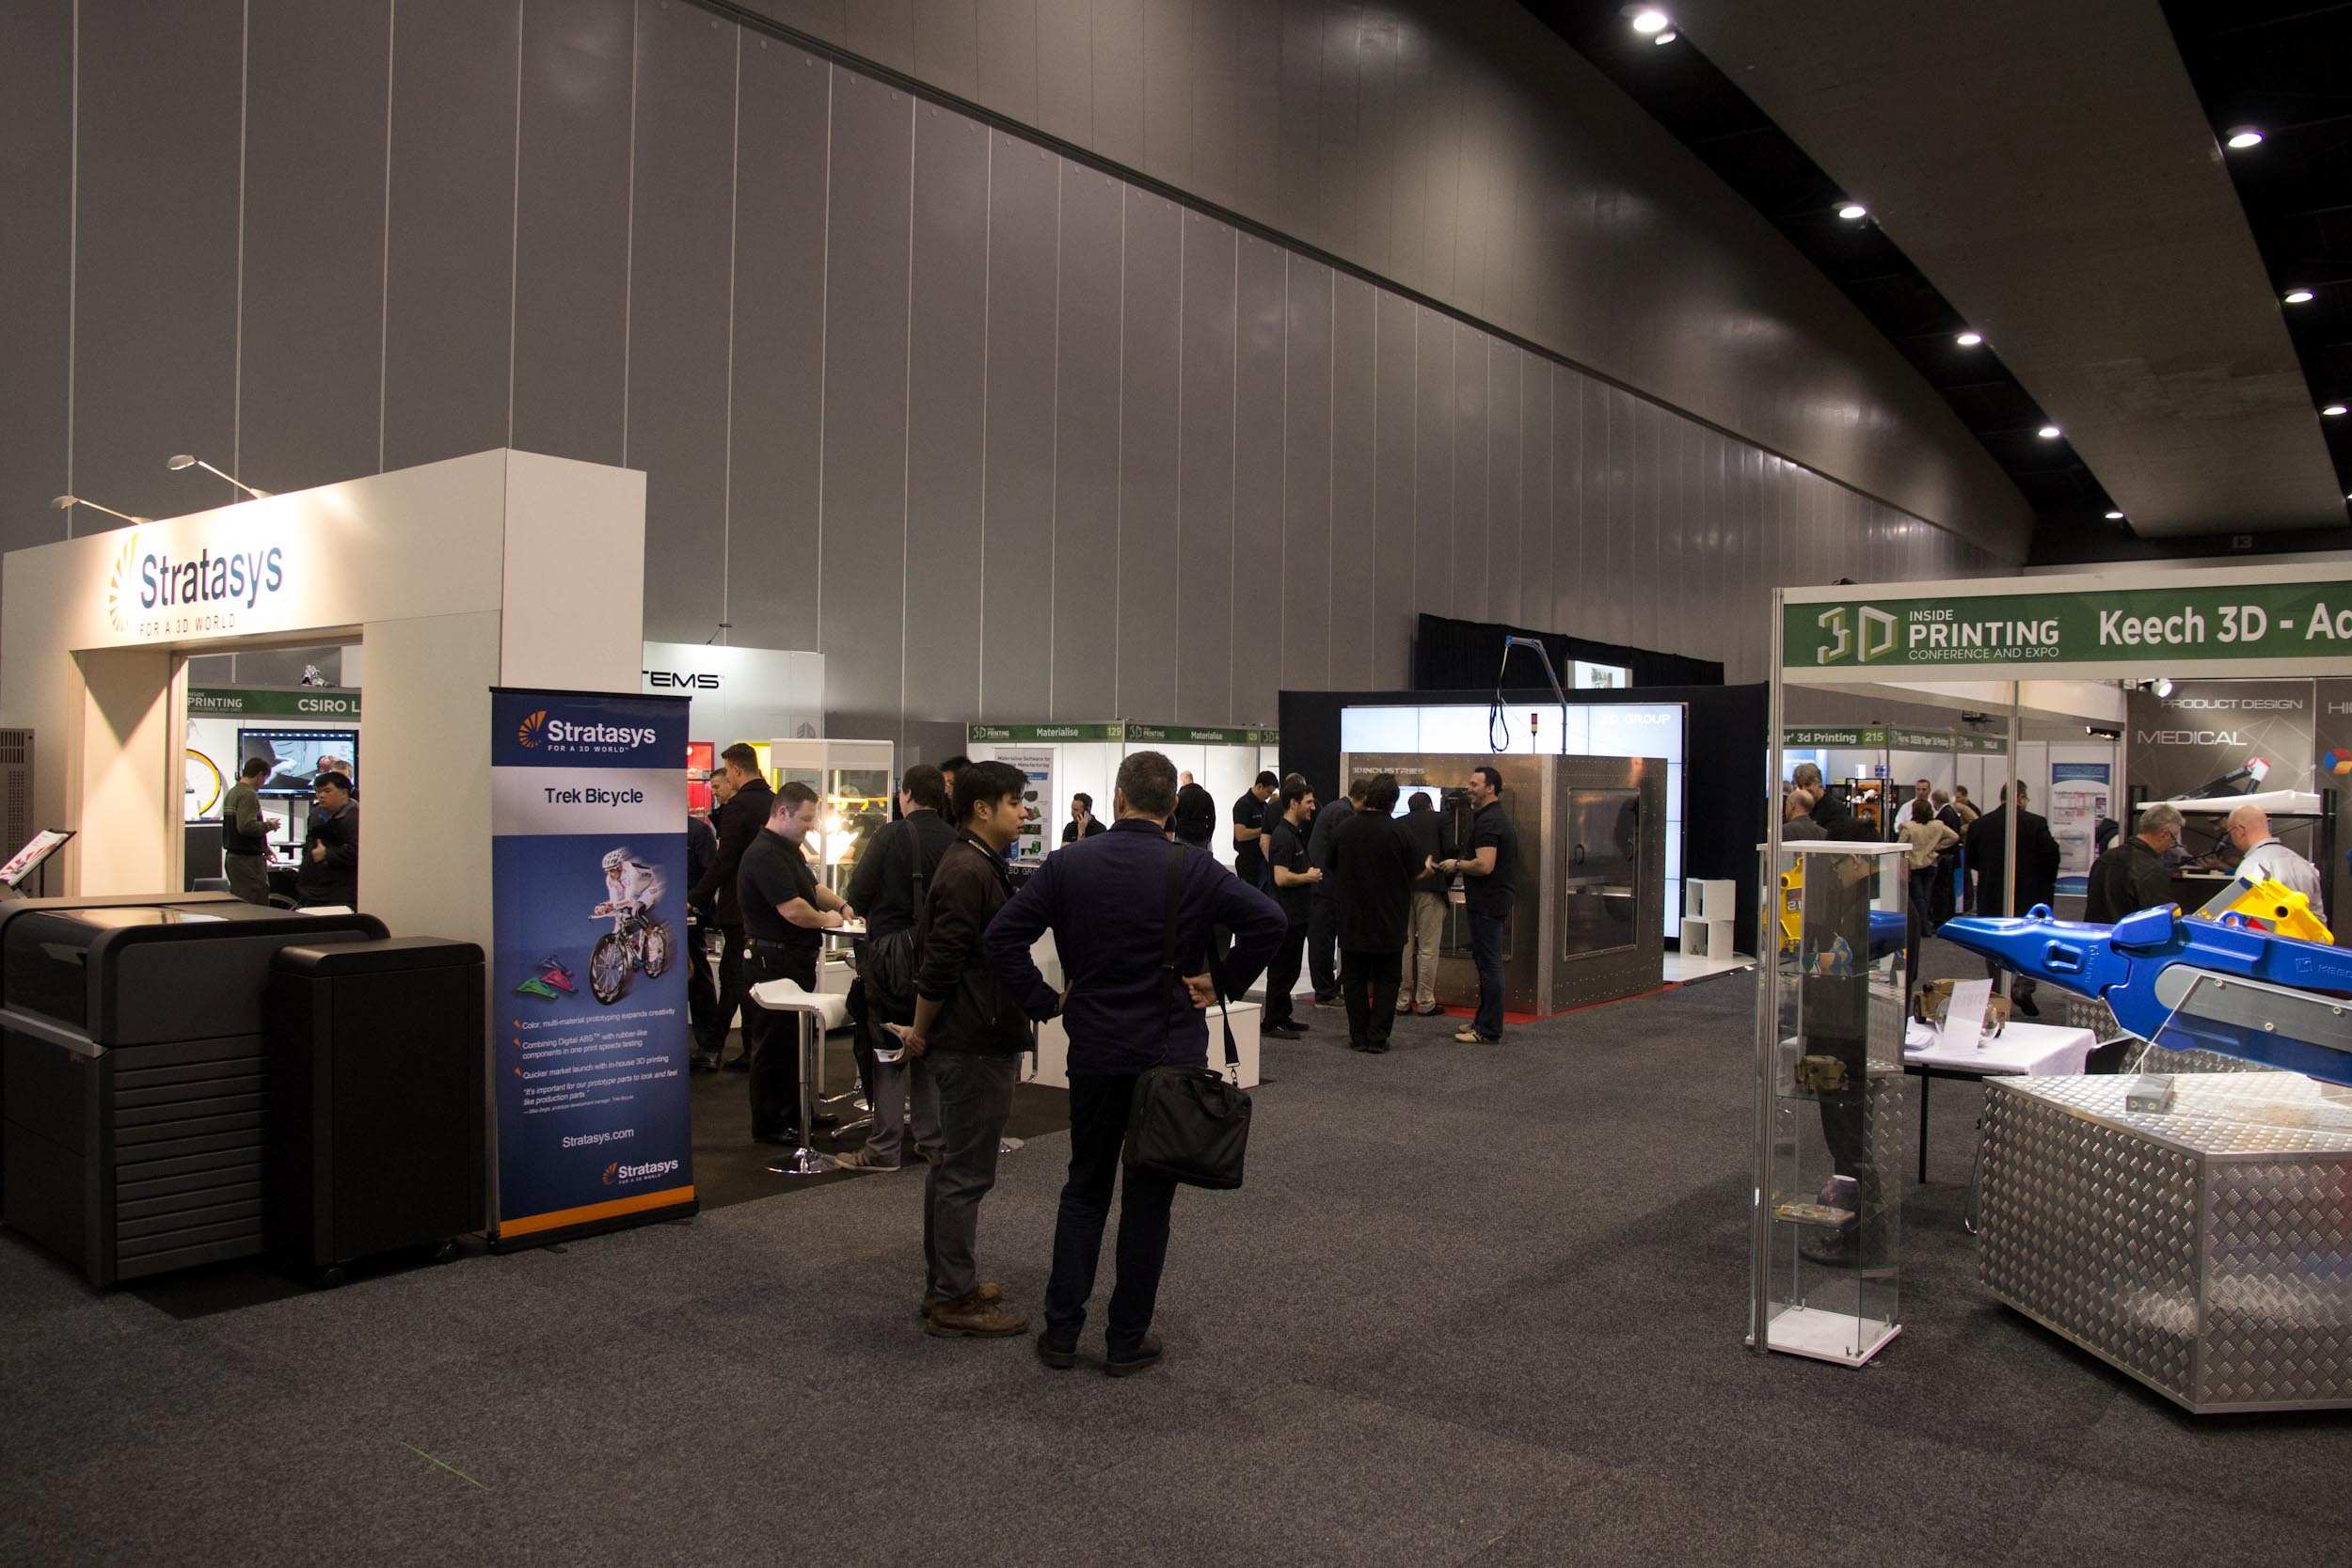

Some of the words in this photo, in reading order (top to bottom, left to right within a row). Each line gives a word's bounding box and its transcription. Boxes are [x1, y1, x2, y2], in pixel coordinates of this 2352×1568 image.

[140, 547, 282, 610] Stratasys
[140, 622, 159, 638] FOR
[165, 623, 171, 636] A
[176, 618, 189, 634] 3D
[195, 612, 235, 632] WORLD
[1909, 610, 1954, 622] INSIDE
[1908, 619, 2059, 649] PRINTING
[2099, 607, 2205, 646] Keech
[2217, 606, 2267, 643] 3D
[1908, 648, 1990, 660] CONFERENCE
[1994, 647, 2022, 659] AND
[2025, 646, 2059, 658] EXPO
[642, 670, 720, 689] EMS
[187, 697, 243, 708] PRINTING
[297, 698, 347, 713] CSIRO
[2161, 699, 2240, 709] PRODUCT
[2241, 699, 2303, 709] DESIGN
[2328, 702, 2352, 715] HI
[547, 720, 657, 748] Stratasys
[1036, 724, 1078, 737] Materialise
[1106, 727, 1122, 736] 129
[1797, 733, 1811, 742] 3d
[1814, 733, 1857, 744] Printing
[1865, 732, 1883, 742] 215
[2137, 730, 2248, 746] MEDICAL
[545, 787, 582, 804] Trek
[586, 787, 644, 807] Bicycle
[543, 1017, 585, 1028] multi-material
[585, 1013, 622, 1024] prototyping
[621, 1010, 648, 1020] expands
[648, 1007, 676, 1018] creativity
[522, 1039, 557, 1050] Combining
[558, 1037, 580, 1046] Digital
[522, 1049, 563, 1060] components
[583, 1044, 598, 1053] print
[598, 1041, 622, 1052] speeds
[622, 1038, 644, 1048] testing
[522, 1069, 549, 1080] Quicker
[549, 1067, 571, 1076] market
[572, 1064, 594, 1073] launch
[594, 1062, 608, 1070] with
[608, 1059, 635, 1069] in-house
[645, 1054, 670, 1065] printing
[536, 1083, 566, 1094] important
[566, 1082, 576, 1090] for
[587, 1077, 616, 1088] prototype
[616, 1074, 633, 1084] parts
[654, 1070, 666, 1079] and
[666, 1068, 678, 1077] feel
[535, 1092, 569, 1105] production
[562, 1128, 635, 1148] Stratasys.com
[617, 1159, 679, 1179] Stratasys
